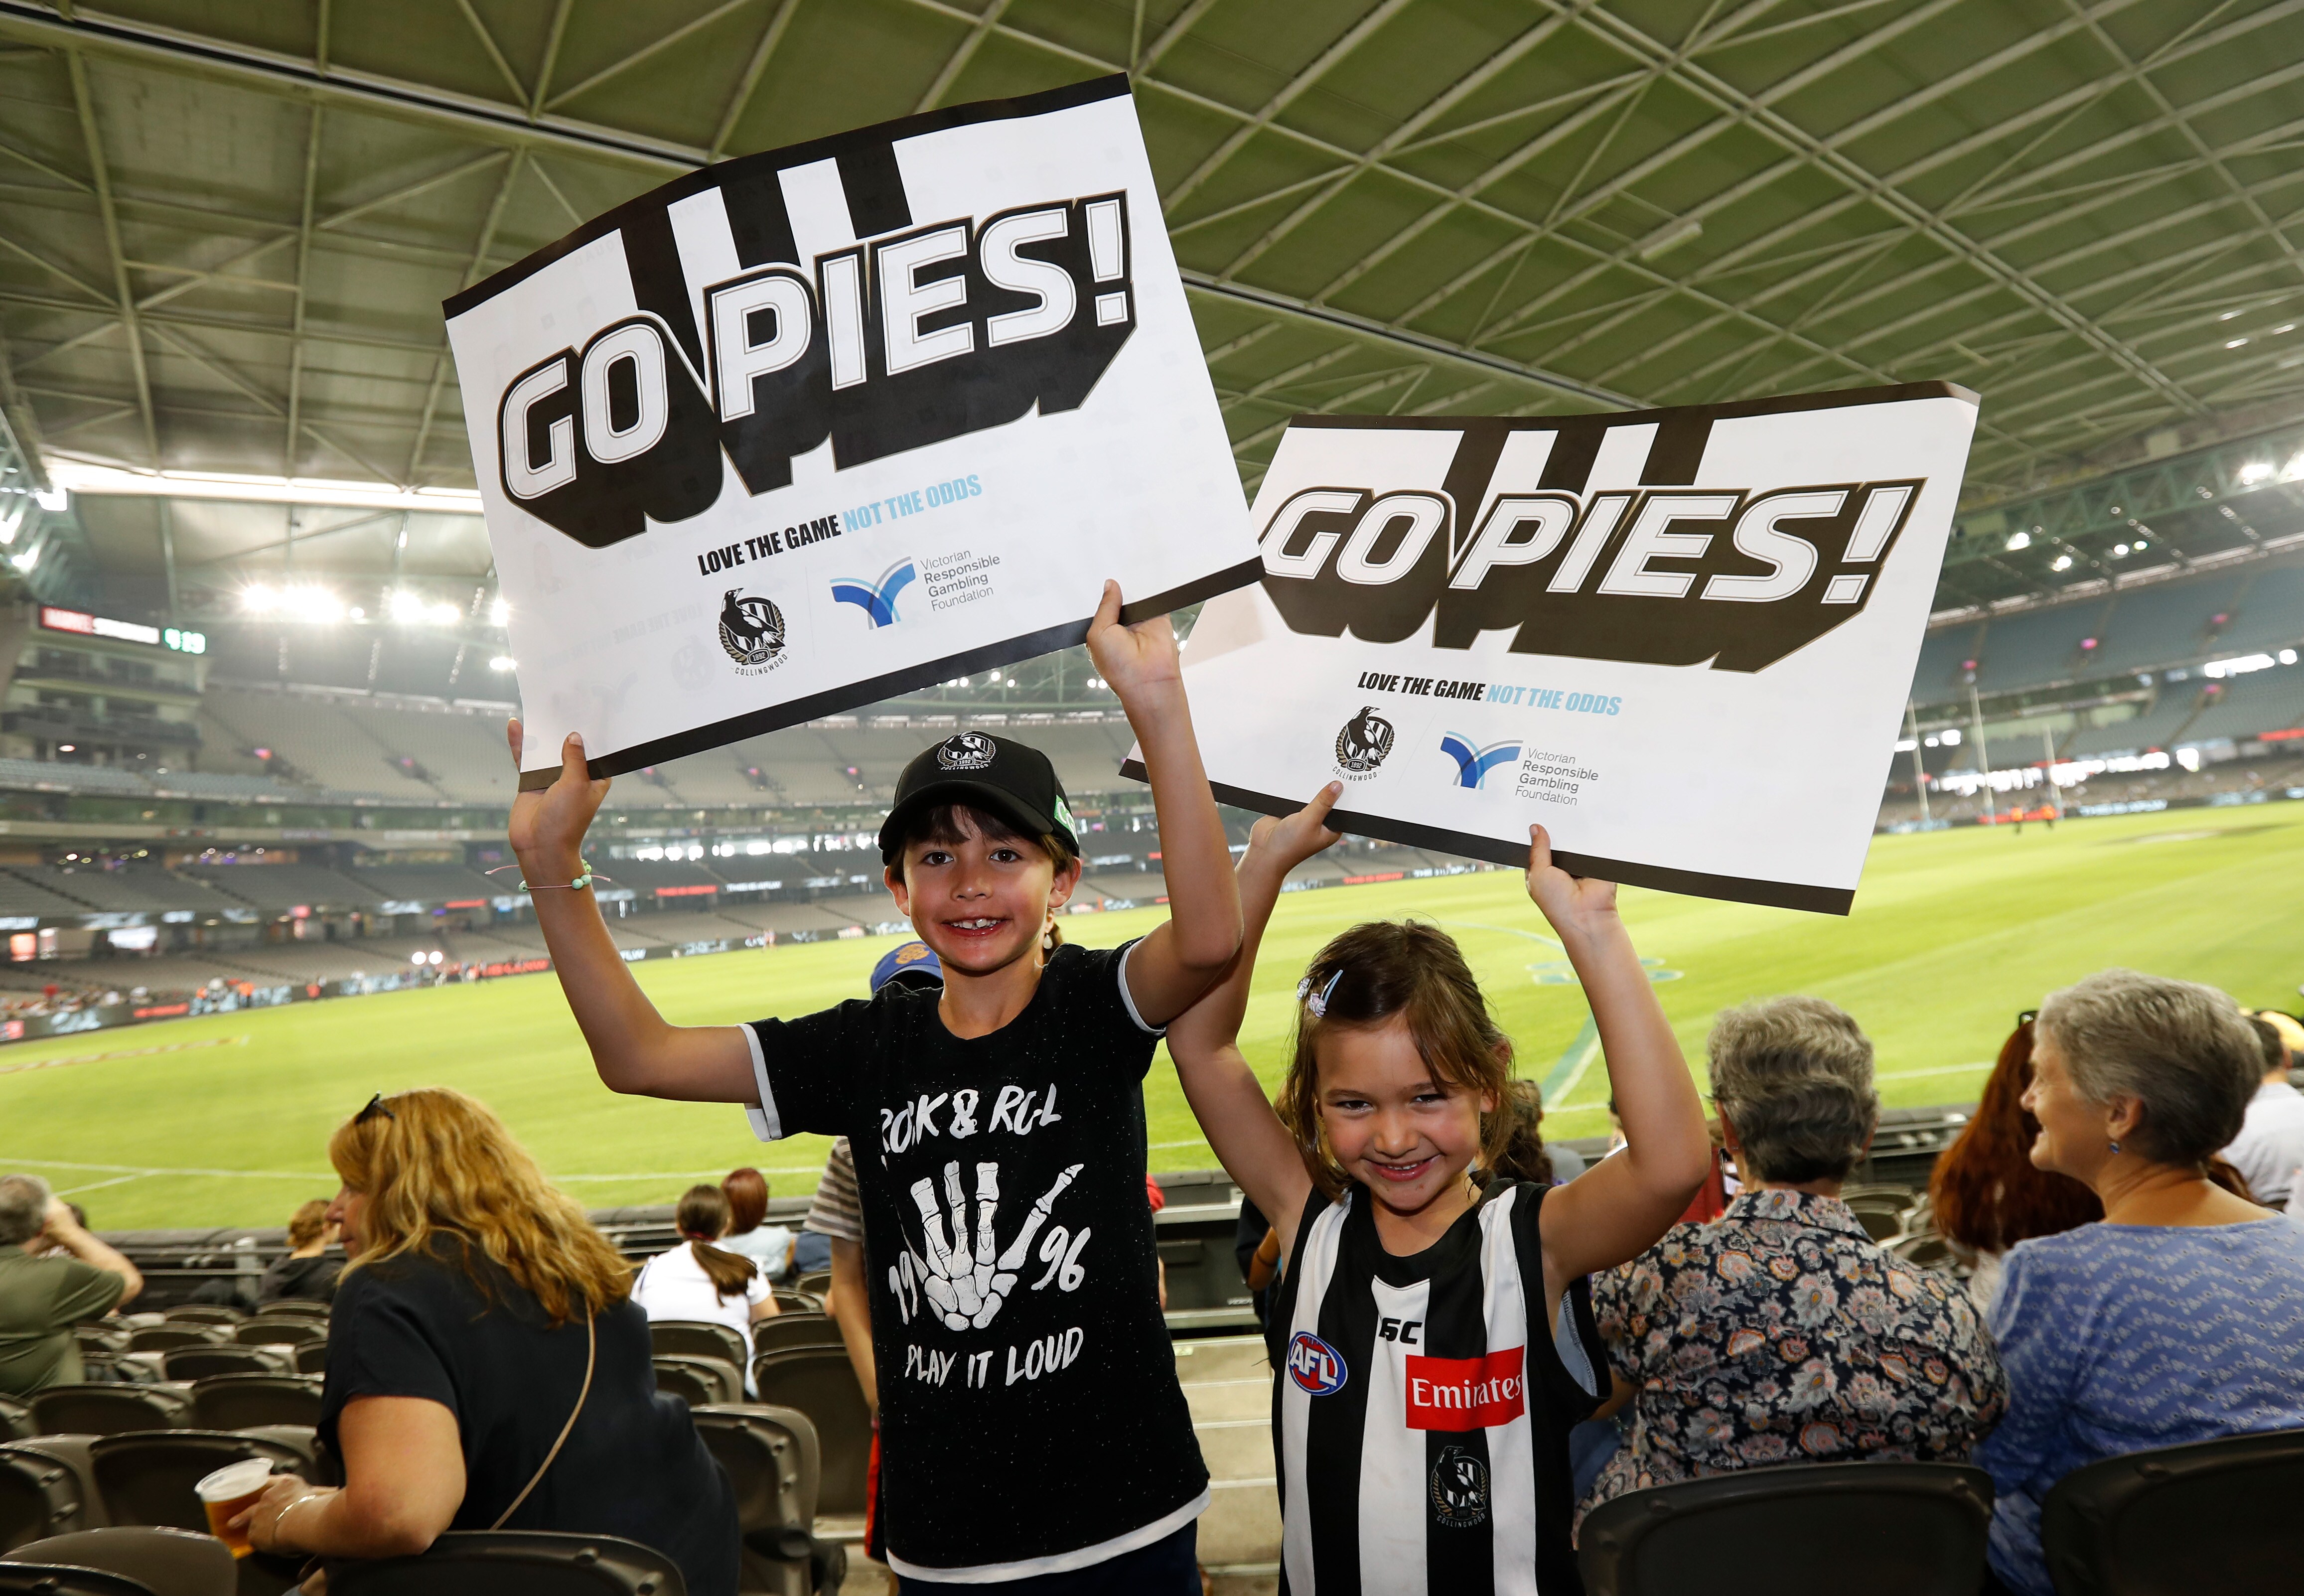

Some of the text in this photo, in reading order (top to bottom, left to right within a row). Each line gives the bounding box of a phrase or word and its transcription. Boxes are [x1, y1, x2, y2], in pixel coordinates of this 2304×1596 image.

[502, 198, 1127, 499] GO PIES!
[698, 474, 982, 576] LOVE THE GAME NOT THE ODDS
[1261, 486, 1913, 604] GO PIES!
[920, 550, 971, 570] Victorian
[924, 555, 1001, 584] Responsible
[928, 574, 989, 597] Gambling
[931, 587, 994, 611] Foundation
[735, 654, 788, 676] COLLINGWOOD
[751, 652, 766, 661] 1892
[1357, 672, 1622, 716] LOVE THE GAME NOT THE ODDS
[1528, 747, 1576, 764] Victorian
[1332, 766, 1377, 781] COLLINGWOOD
[1522, 760, 1599, 780] Responsible
[1519, 773, 1580, 794] Gambling
[1515, 785, 1578, 806] Foundation
[1031, 1225, 1091, 1293] 96
[905, 1326, 1084, 1389] PLAY IT LOUD
[1289, 1340, 1337, 1387] AFL
[1411, 1373, 1522, 1409] Emirates
[1437, 1513, 1485, 1528] COLLINGWOOD
